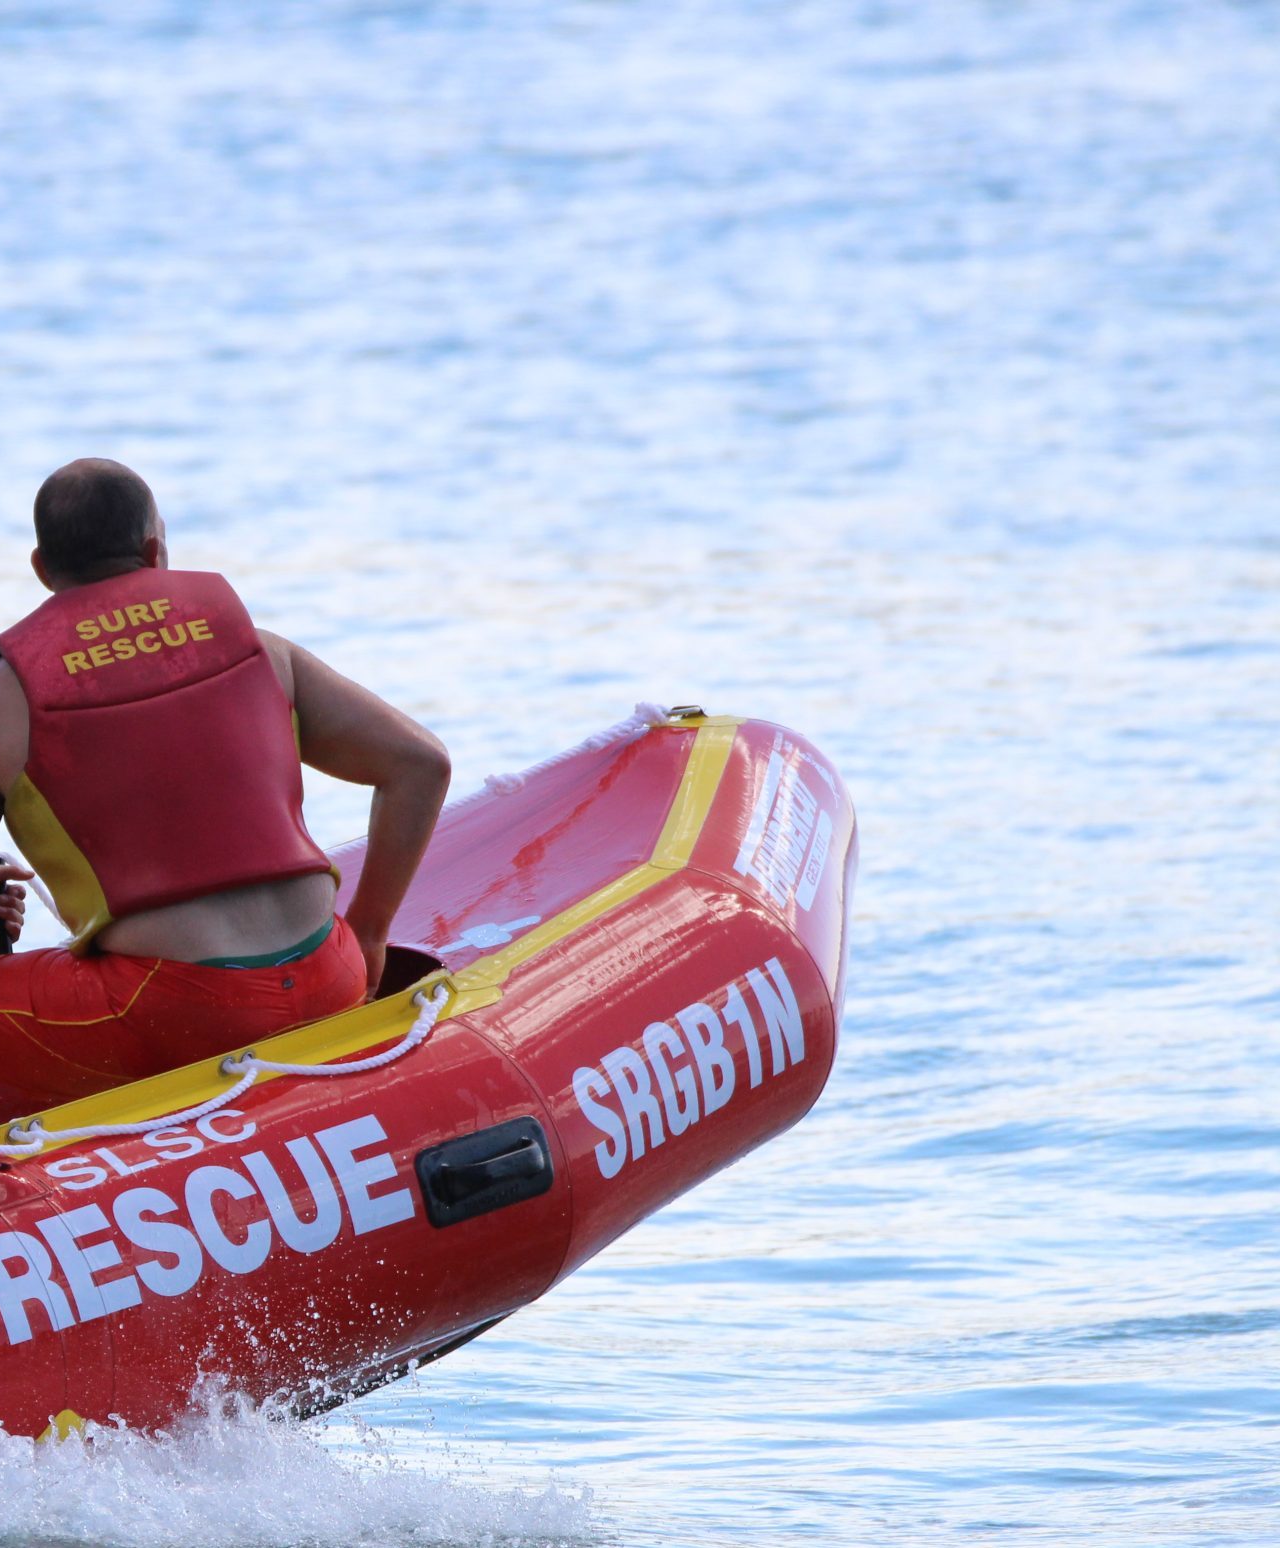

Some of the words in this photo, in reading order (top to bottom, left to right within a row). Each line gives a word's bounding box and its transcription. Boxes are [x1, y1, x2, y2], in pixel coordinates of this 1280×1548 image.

[62, 618, 213, 674] RESCUE
[76, 599, 171, 640] SURF
[573, 957, 805, 1179] SRGB1N
[46, 1109, 257, 1191] SLSC
